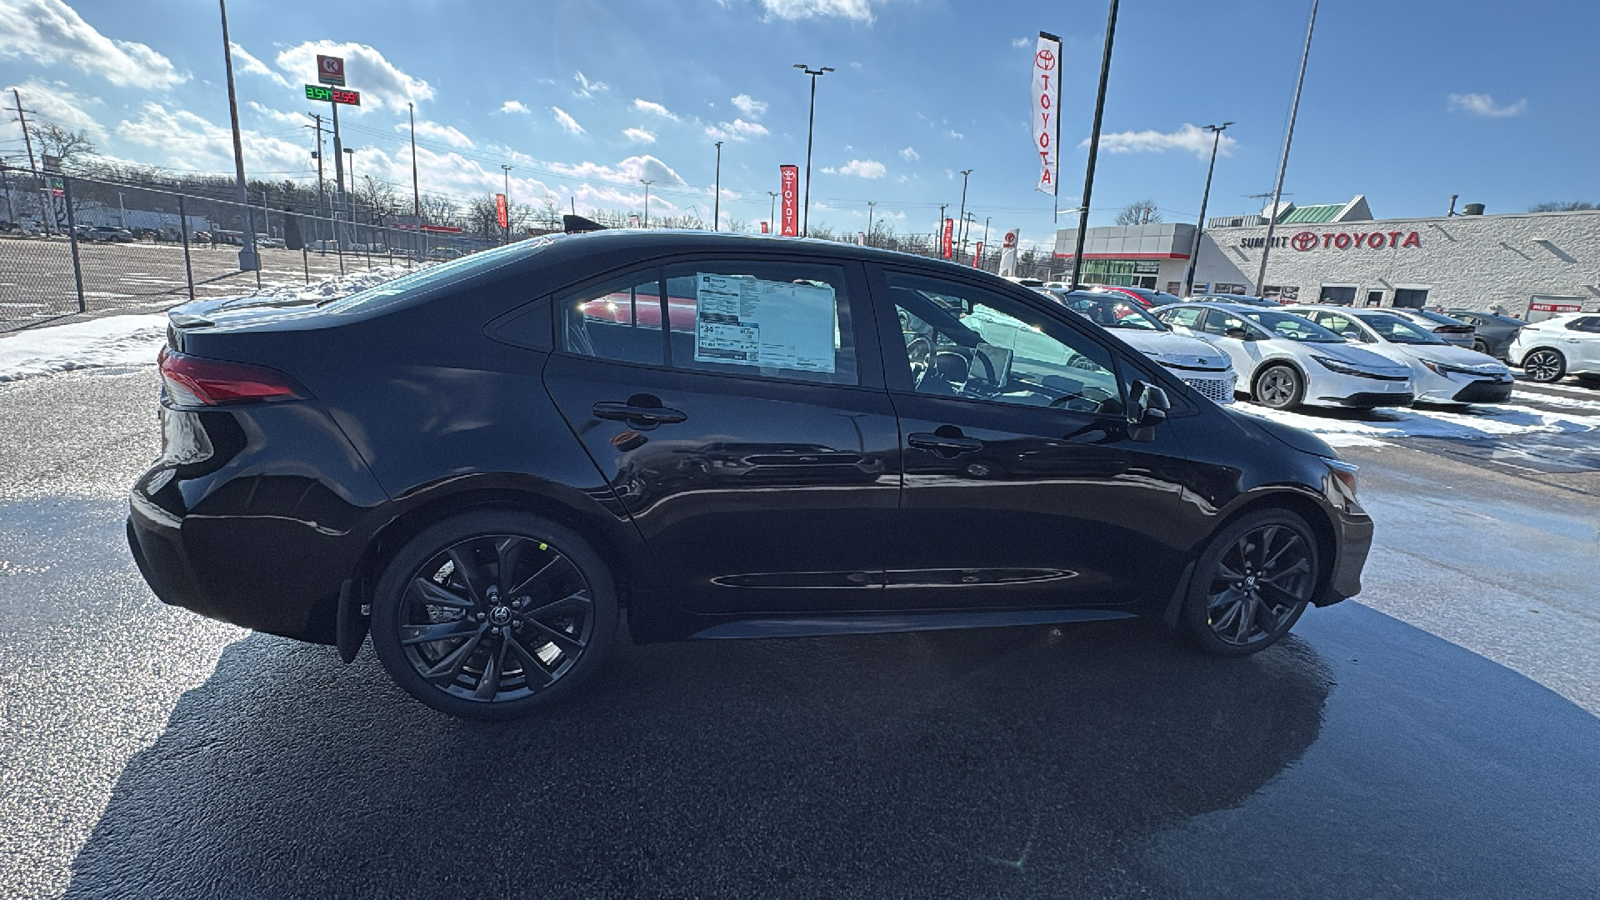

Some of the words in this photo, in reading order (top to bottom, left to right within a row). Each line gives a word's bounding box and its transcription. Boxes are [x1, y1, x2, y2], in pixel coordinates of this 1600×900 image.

[326, 61, 337, 73] K
[1040, 75, 1051, 184] TOYOTA
[784, 181, 793, 234] TOYOTA
[1322, 231, 1420, 249] TOYOTA
